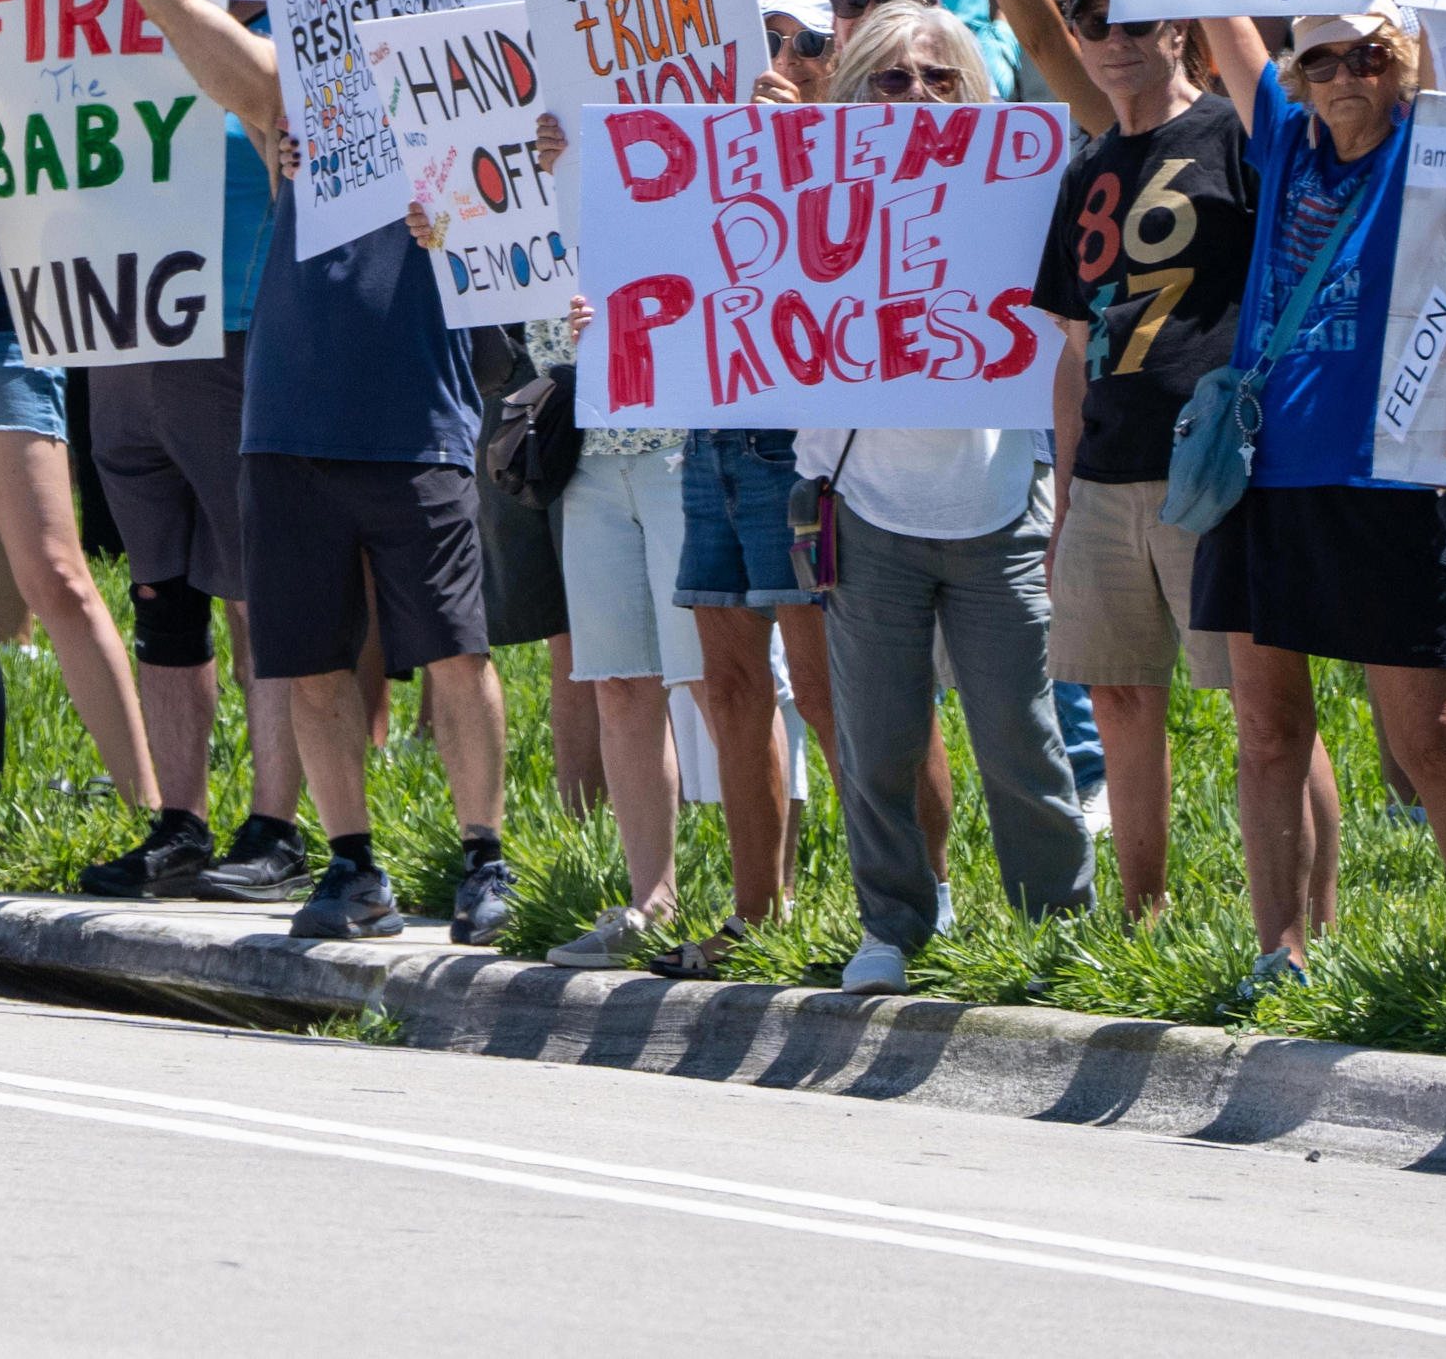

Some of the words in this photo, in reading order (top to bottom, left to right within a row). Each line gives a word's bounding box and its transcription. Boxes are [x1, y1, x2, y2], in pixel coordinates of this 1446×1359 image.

[397, 30, 538, 125] HAND
[311, 136, 375, 184] PROTECT
[604, 104, 1063, 203] DEFEND
[1413, 143, 1421, 166] I
[712, 179, 947, 300] DUE
[1077, 158, 1197, 283] 86
[10, 251, 206, 357] KING
[606, 274, 1038, 413] PROCESS
[1085, 267, 1195, 382] 47
